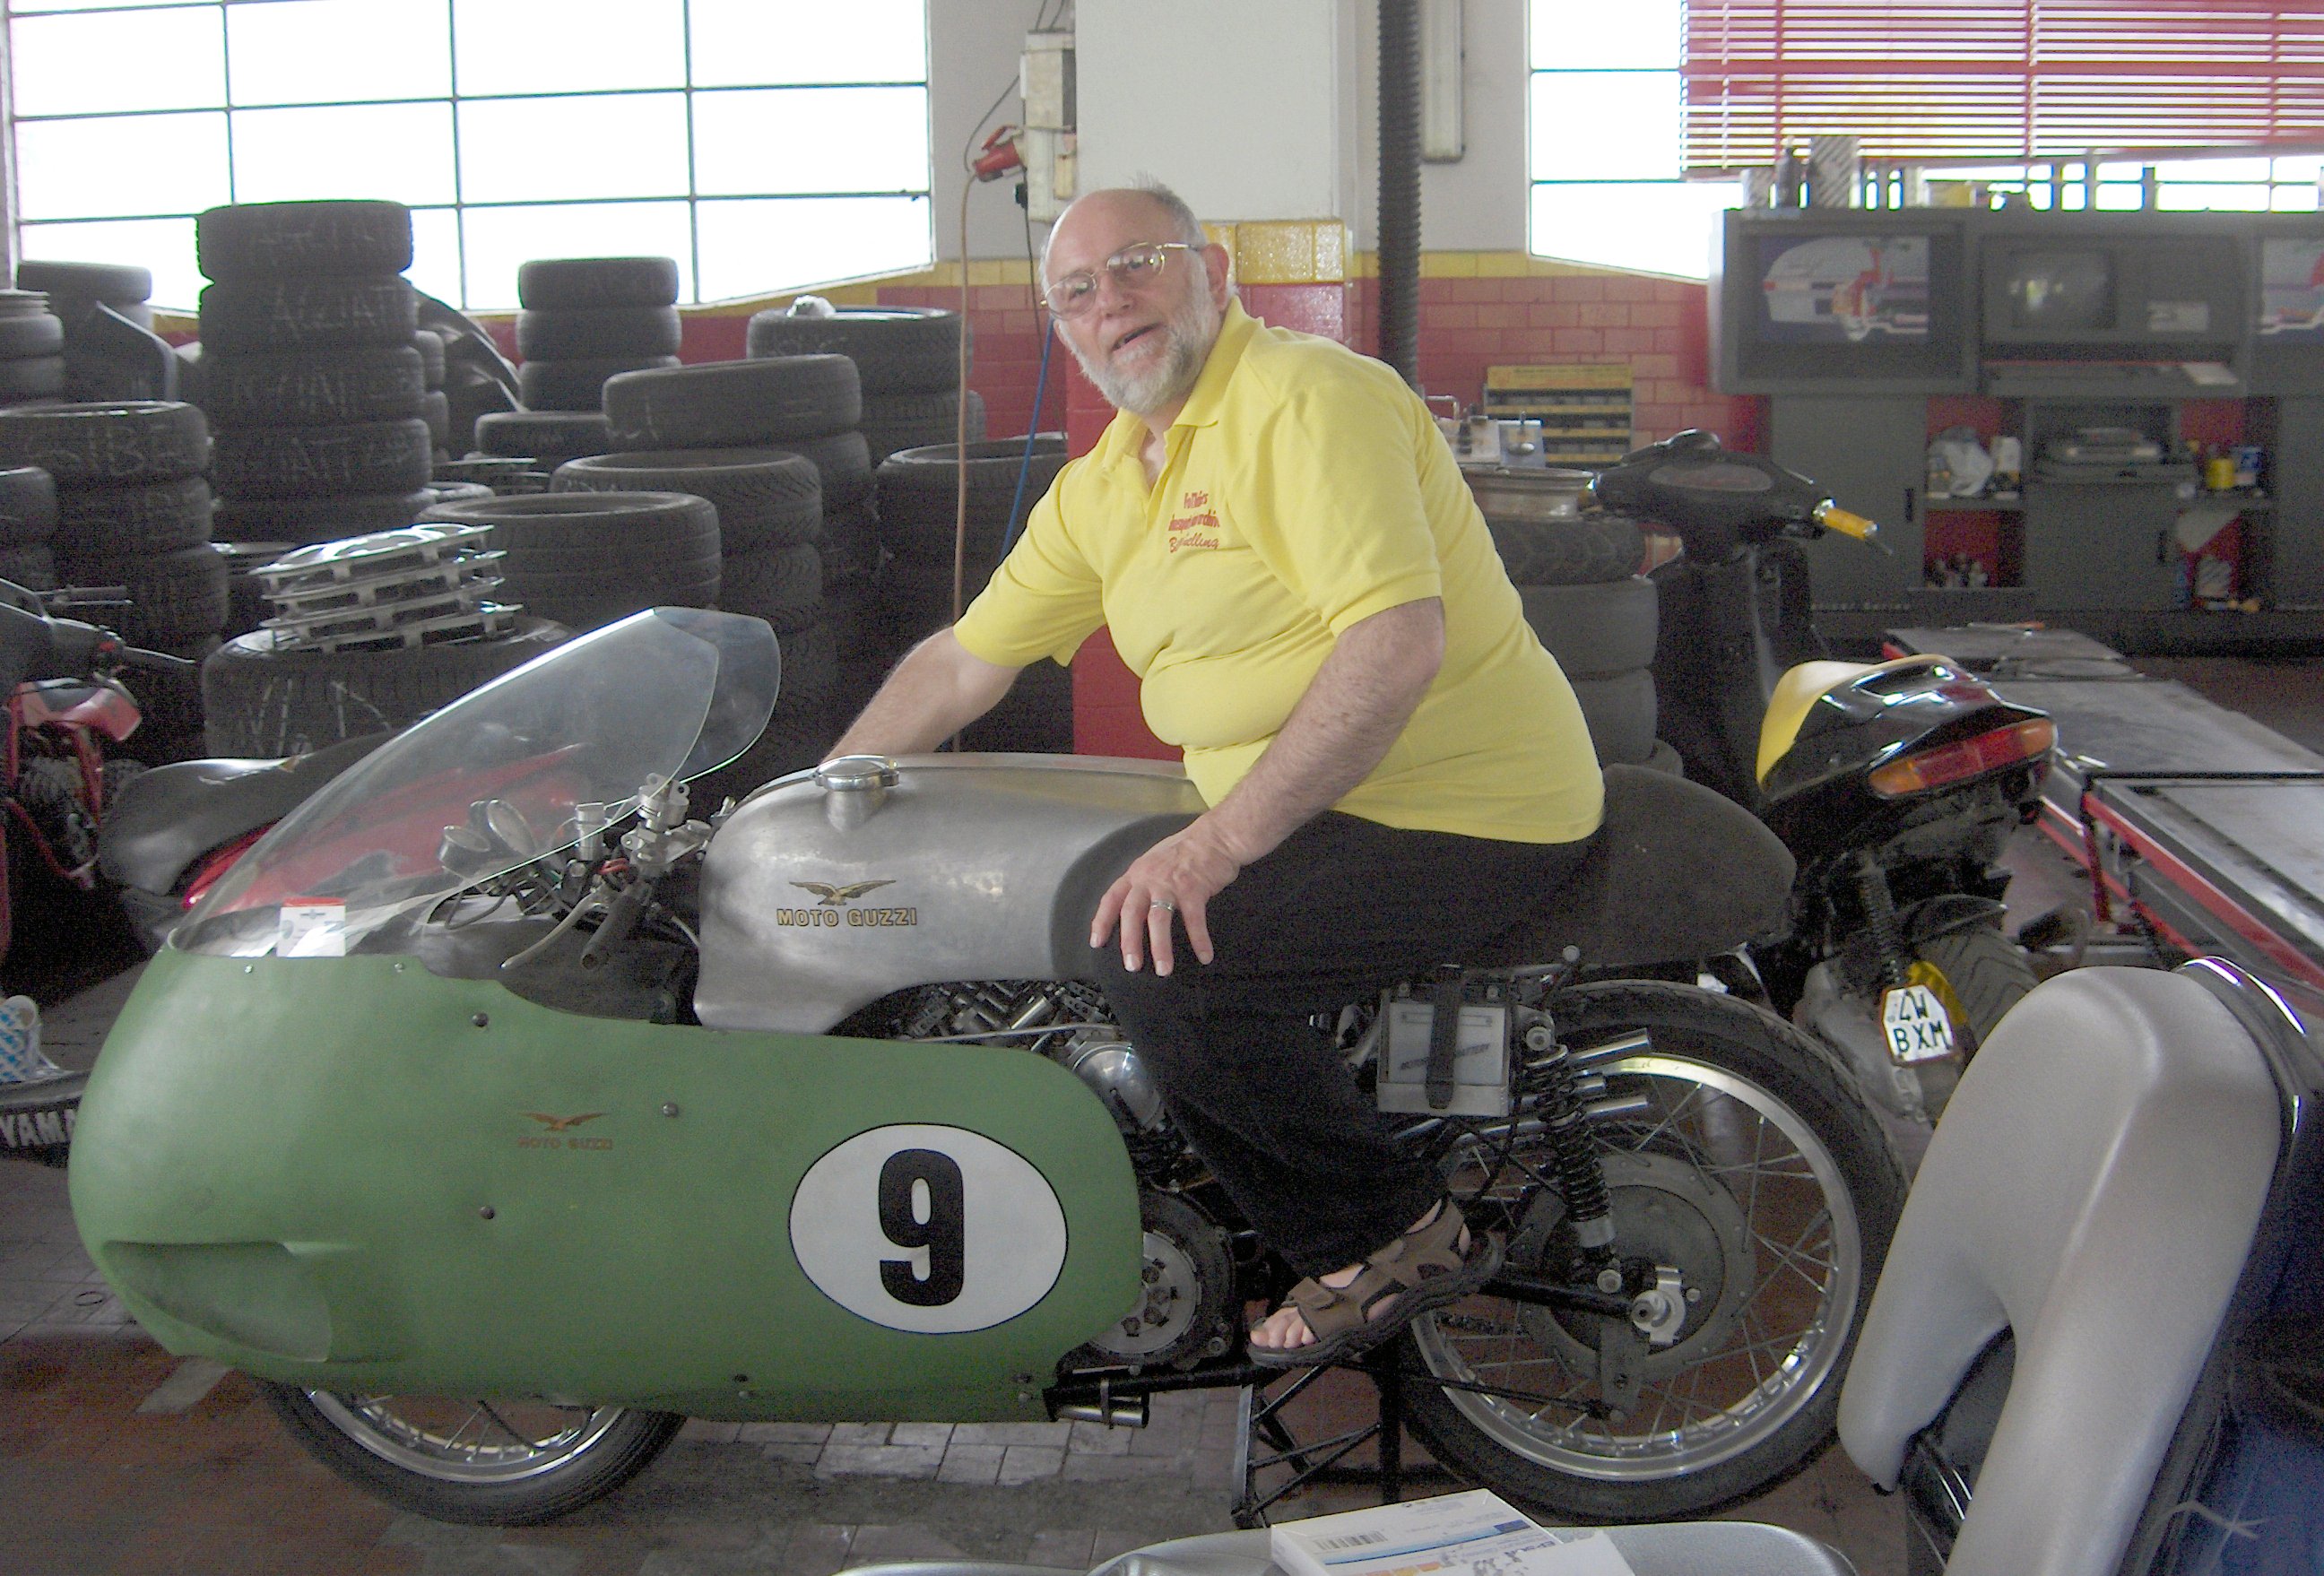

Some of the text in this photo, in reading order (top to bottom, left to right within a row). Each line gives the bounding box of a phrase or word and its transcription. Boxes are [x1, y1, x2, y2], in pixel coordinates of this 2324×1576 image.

[776, 907, 917, 927] MOTO GUZZI
[1893, 1020, 1951, 1053] BXM
[878, 1147, 965, 1306] 9
